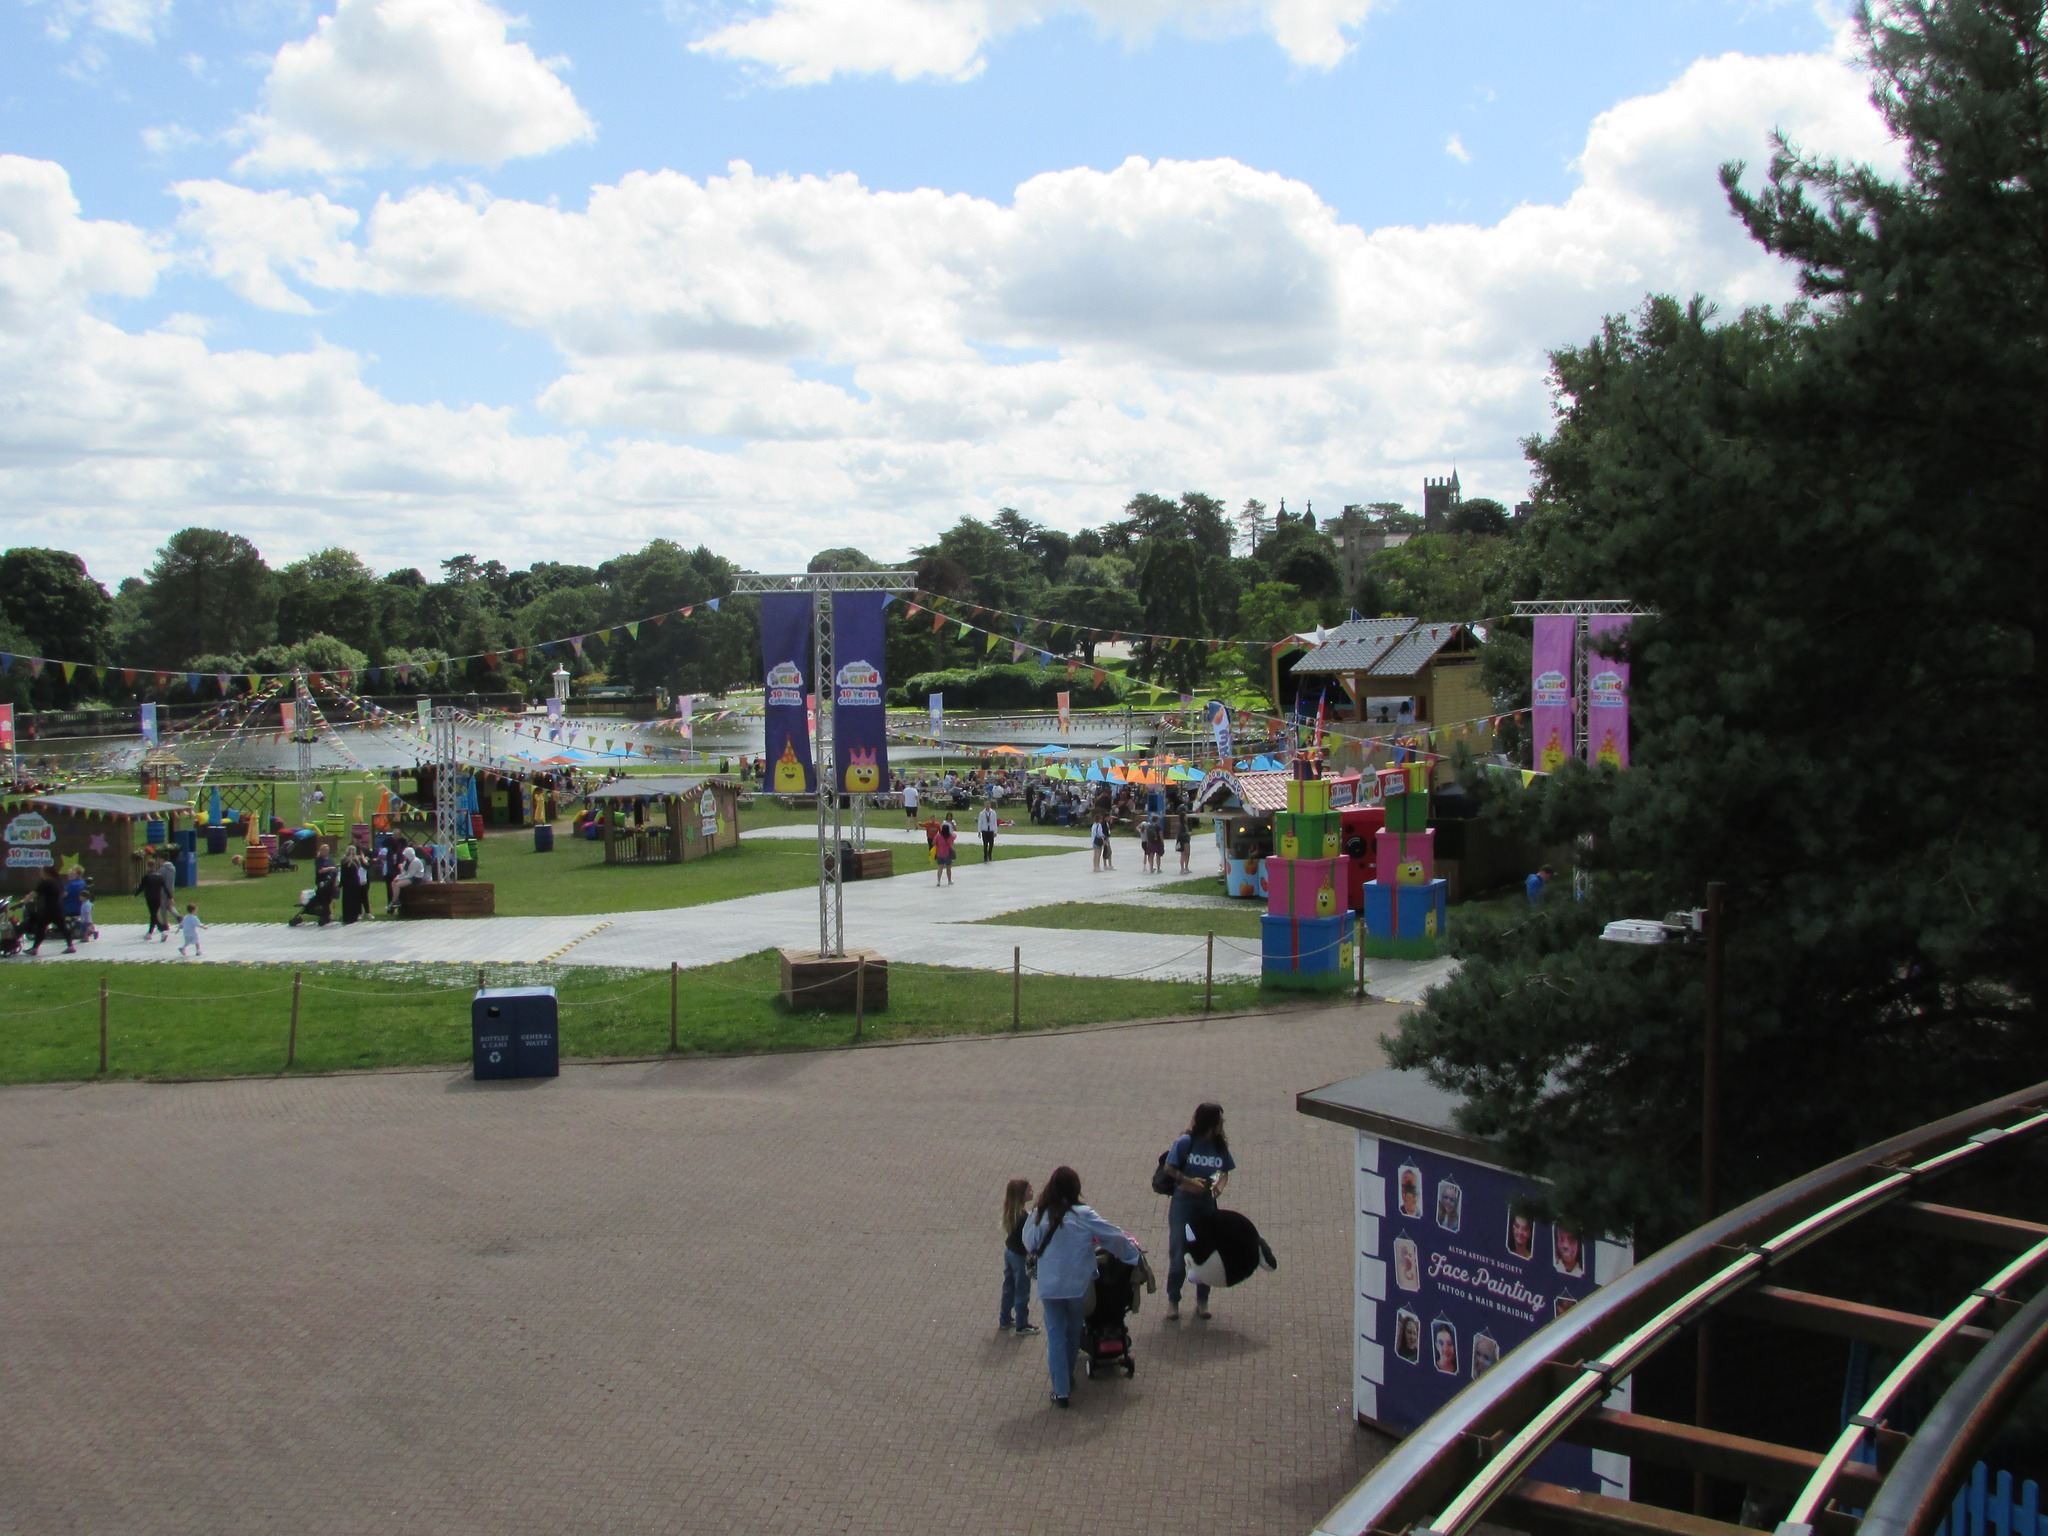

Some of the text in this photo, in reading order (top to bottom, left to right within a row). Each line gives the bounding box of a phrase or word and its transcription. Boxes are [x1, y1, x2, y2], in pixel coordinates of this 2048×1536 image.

[840, 672, 878, 685] Land
[772, 690, 782, 698] 10
[841, 690, 877, 698] 10 Years
[839, 697, 880, 705] Celebration
[9, 848, 50, 857] 10 Years
[1188, 1153, 1224, 1168] RODEO
[1448, 1245, 1523, 1275] ALTON ARTIST'S SOCIETY
[1427, 1252, 1546, 1312] Face Painting
[1437, 1282, 1535, 1322] TATTOO & HAIR BRAIDING
